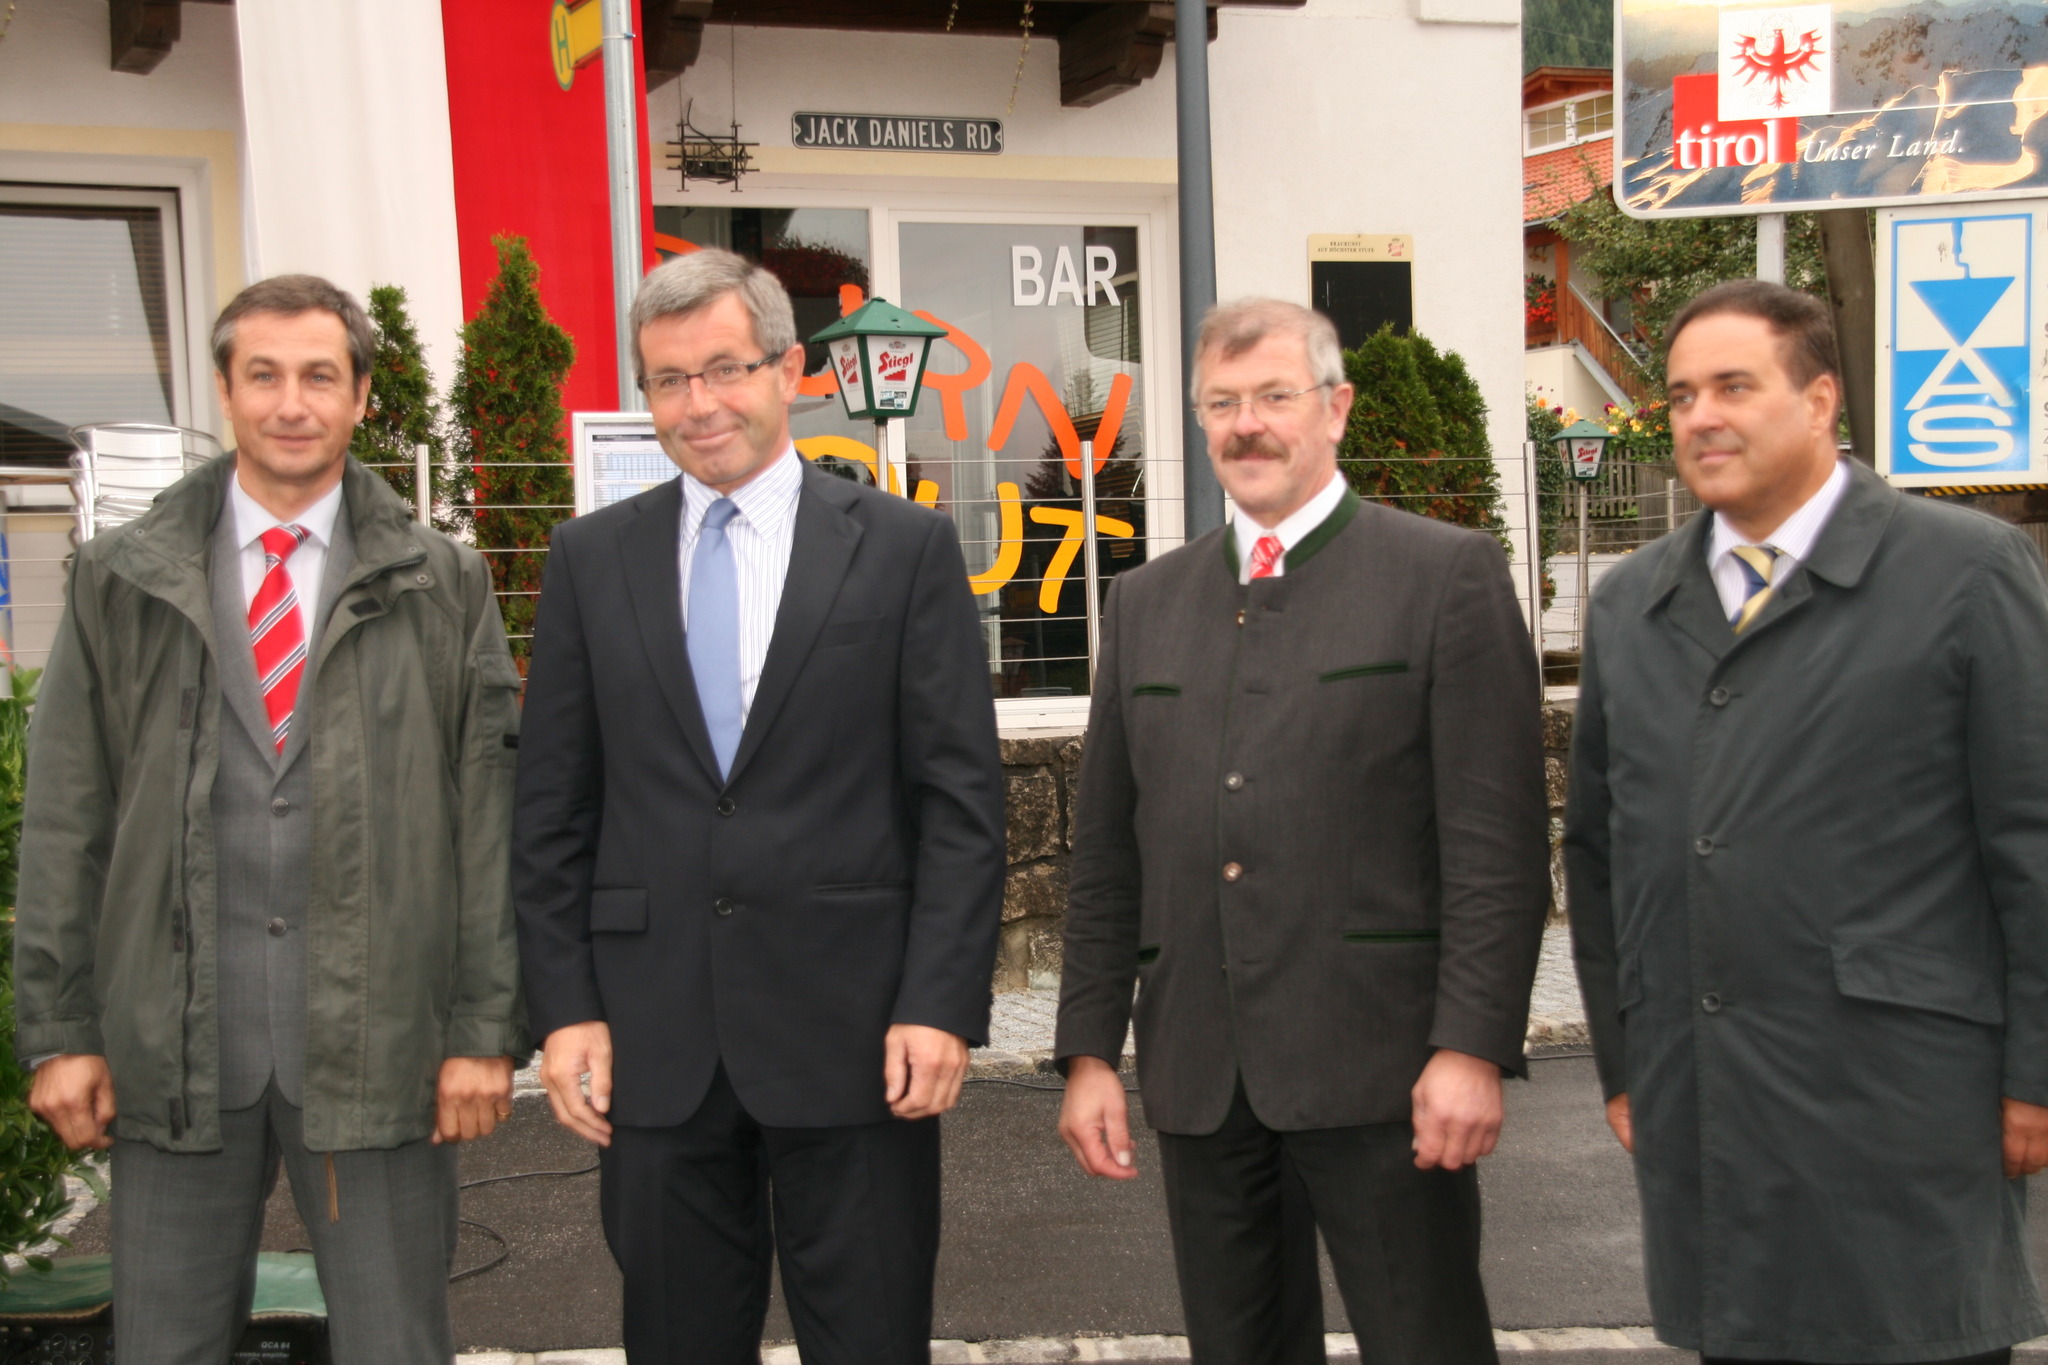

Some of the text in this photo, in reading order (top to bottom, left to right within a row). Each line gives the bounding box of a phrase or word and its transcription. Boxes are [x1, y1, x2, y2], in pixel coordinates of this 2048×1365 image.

[554, 14, 572, 74] H
[804, 117, 992, 150] JACK DANIELS RD
[1675, 119, 1778, 169] tirol
[1803, 130, 1963, 163] Unser Land.
[1011, 245, 1121, 307] BAR
[878, 351, 914, 375] Stiegl
